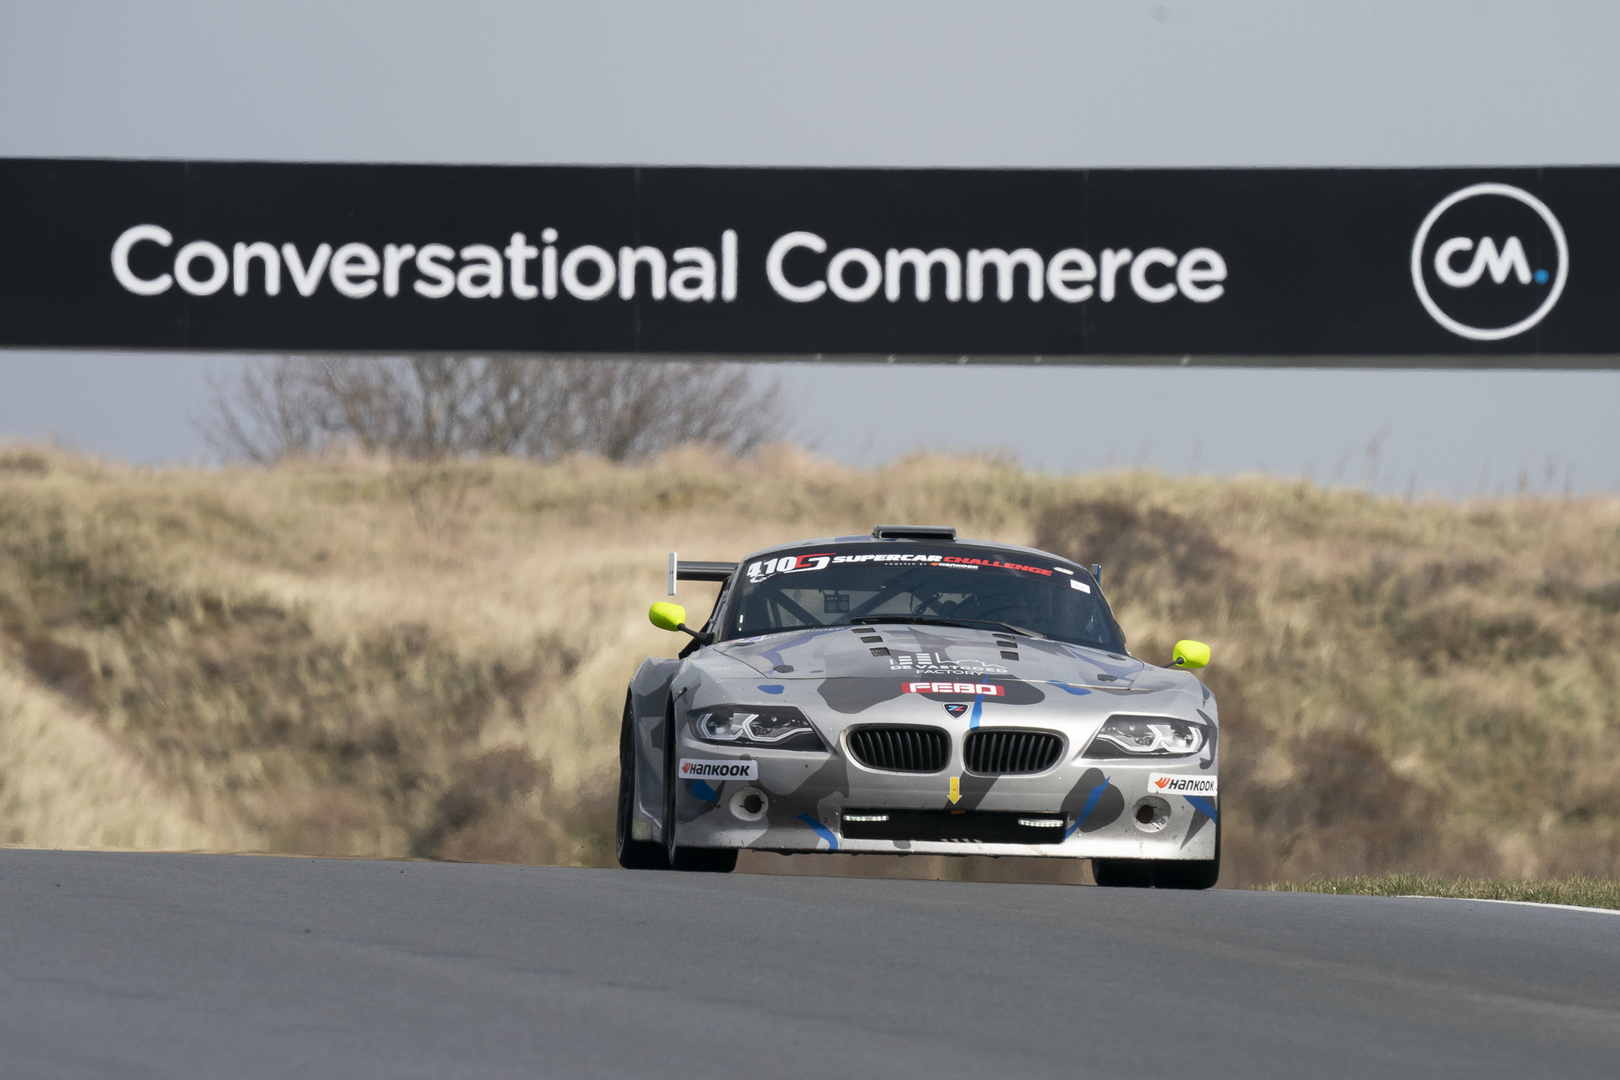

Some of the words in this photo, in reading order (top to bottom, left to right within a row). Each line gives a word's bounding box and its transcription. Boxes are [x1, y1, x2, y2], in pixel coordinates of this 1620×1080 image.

[111, 224, 739, 302] Conversational
[765, 231, 1228, 303] Commerce
[747, 556, 798, 577] 410
[832, 554, 943, 564] SUPERCAR
[943, 556, 1053, 577] CHALLENGE
[915, 664, 1008, 673] VASTGOED
[909, 682, 998, 695] FEBO
